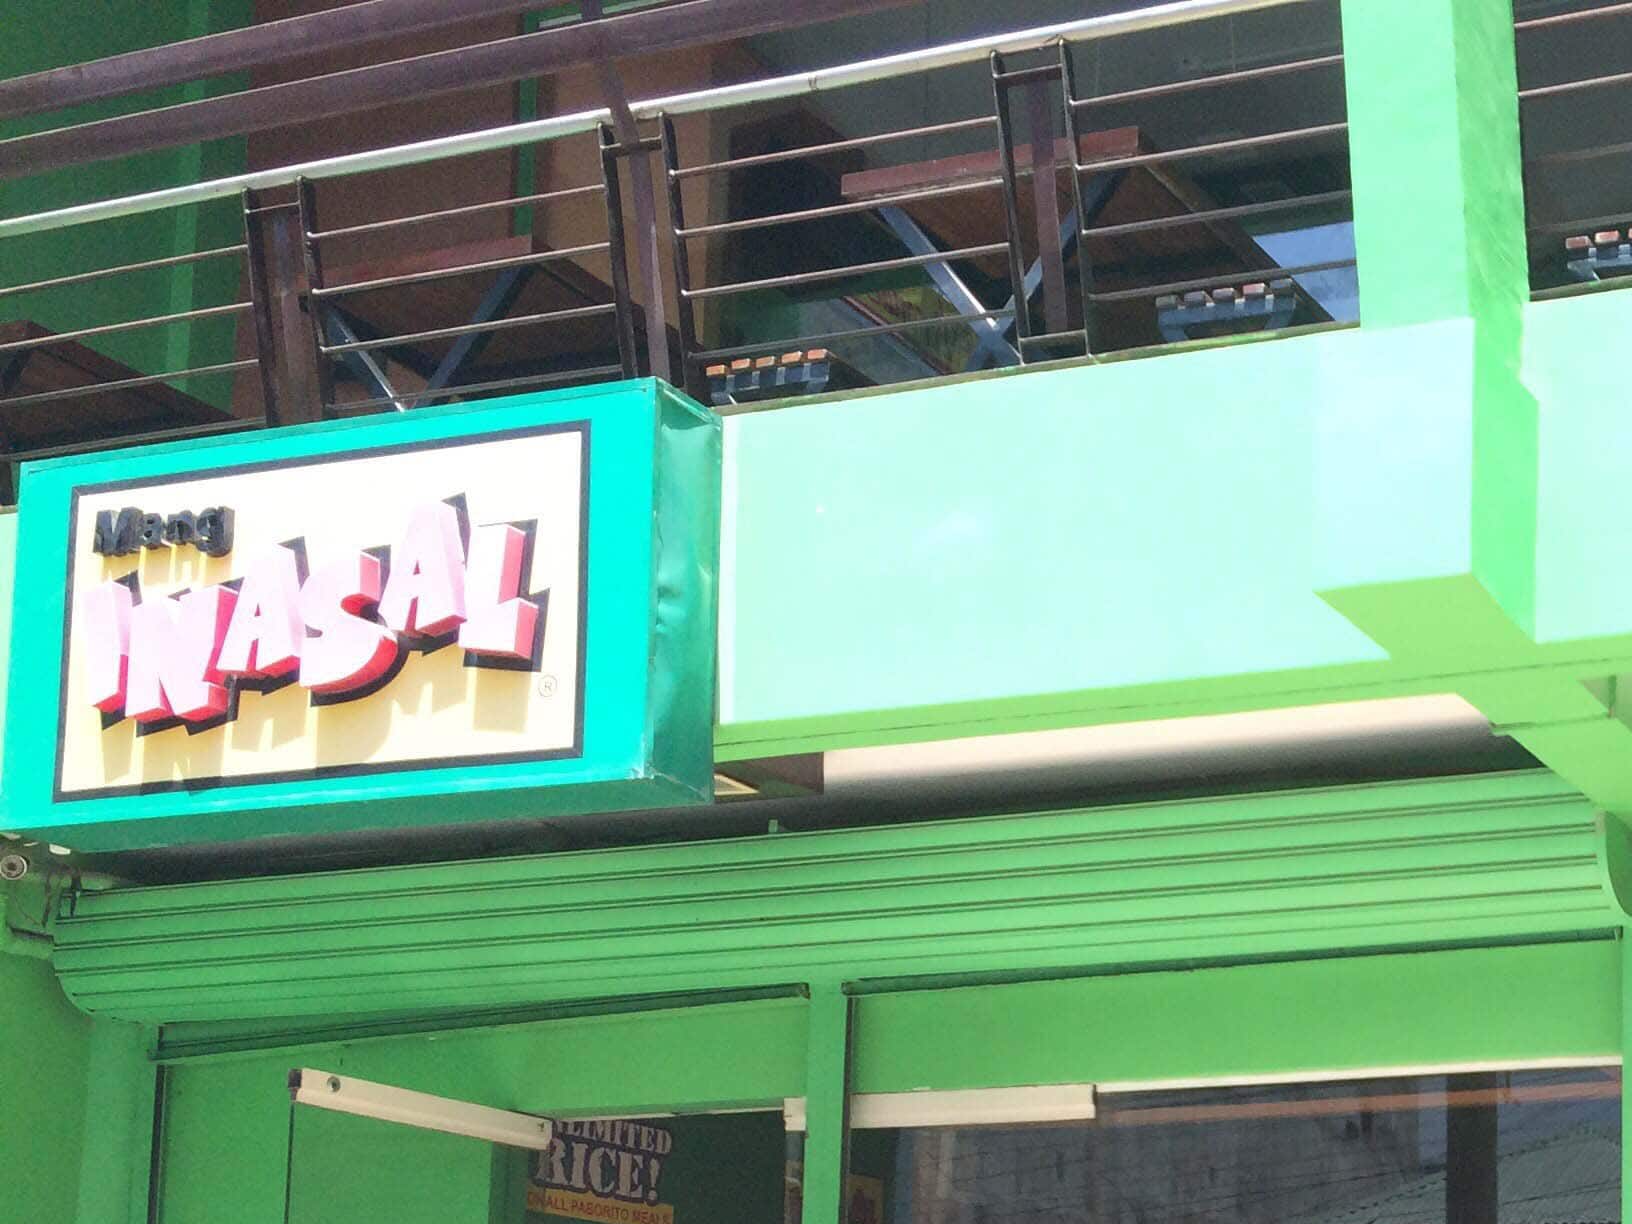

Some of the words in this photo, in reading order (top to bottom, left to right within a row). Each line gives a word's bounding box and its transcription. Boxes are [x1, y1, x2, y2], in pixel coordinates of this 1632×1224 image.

[93, 505, 235, 558] Mang
[84, 492, 549, 736] INASAL
[555, 1120, 673, 1154] LIMITED
[535, 1138, 660, 1201] RICE!
[547, 1194, 568, 1211] ALL
